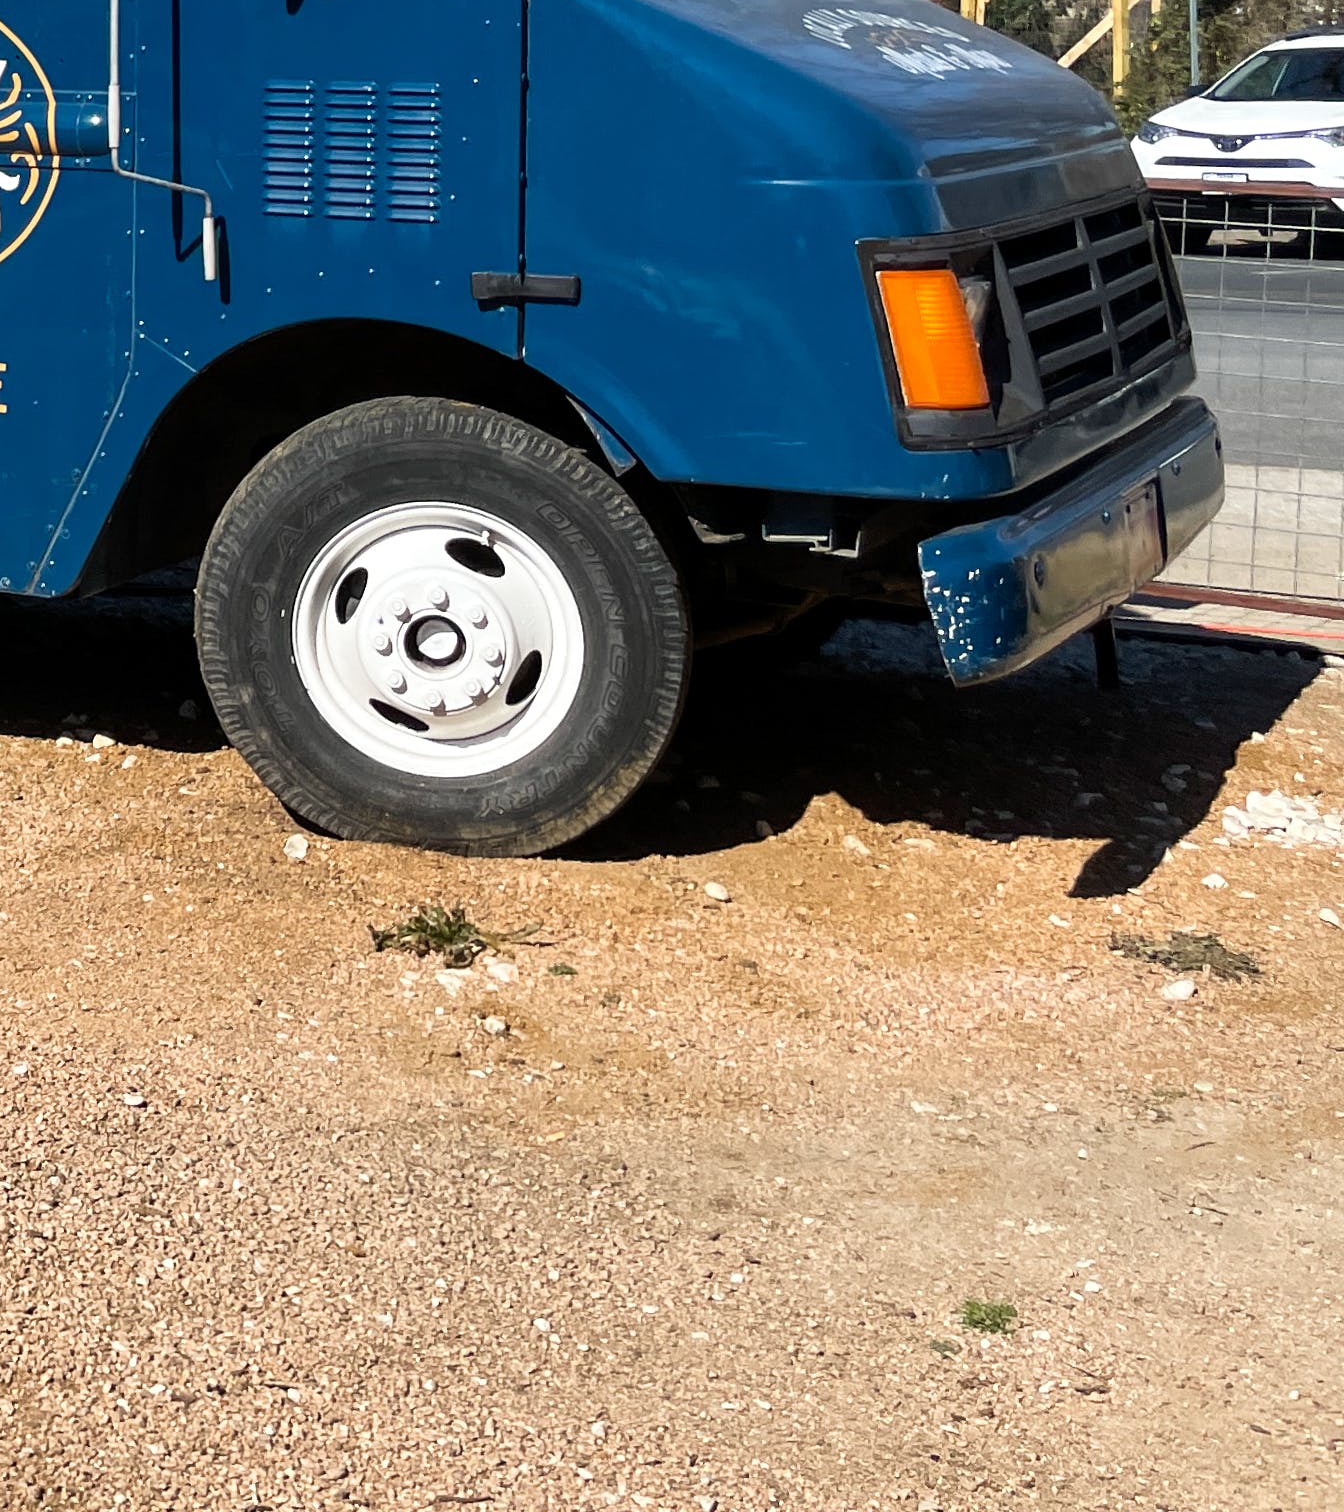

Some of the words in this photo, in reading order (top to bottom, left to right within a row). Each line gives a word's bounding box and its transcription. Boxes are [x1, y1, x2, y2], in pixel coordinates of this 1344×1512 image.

[277, 483, 345, 561] A/T
[535, 502, 626, 622] OPEN
[248, 586, 296, 732] TOYO
[479, 643, 630, 820] COUNTRY
